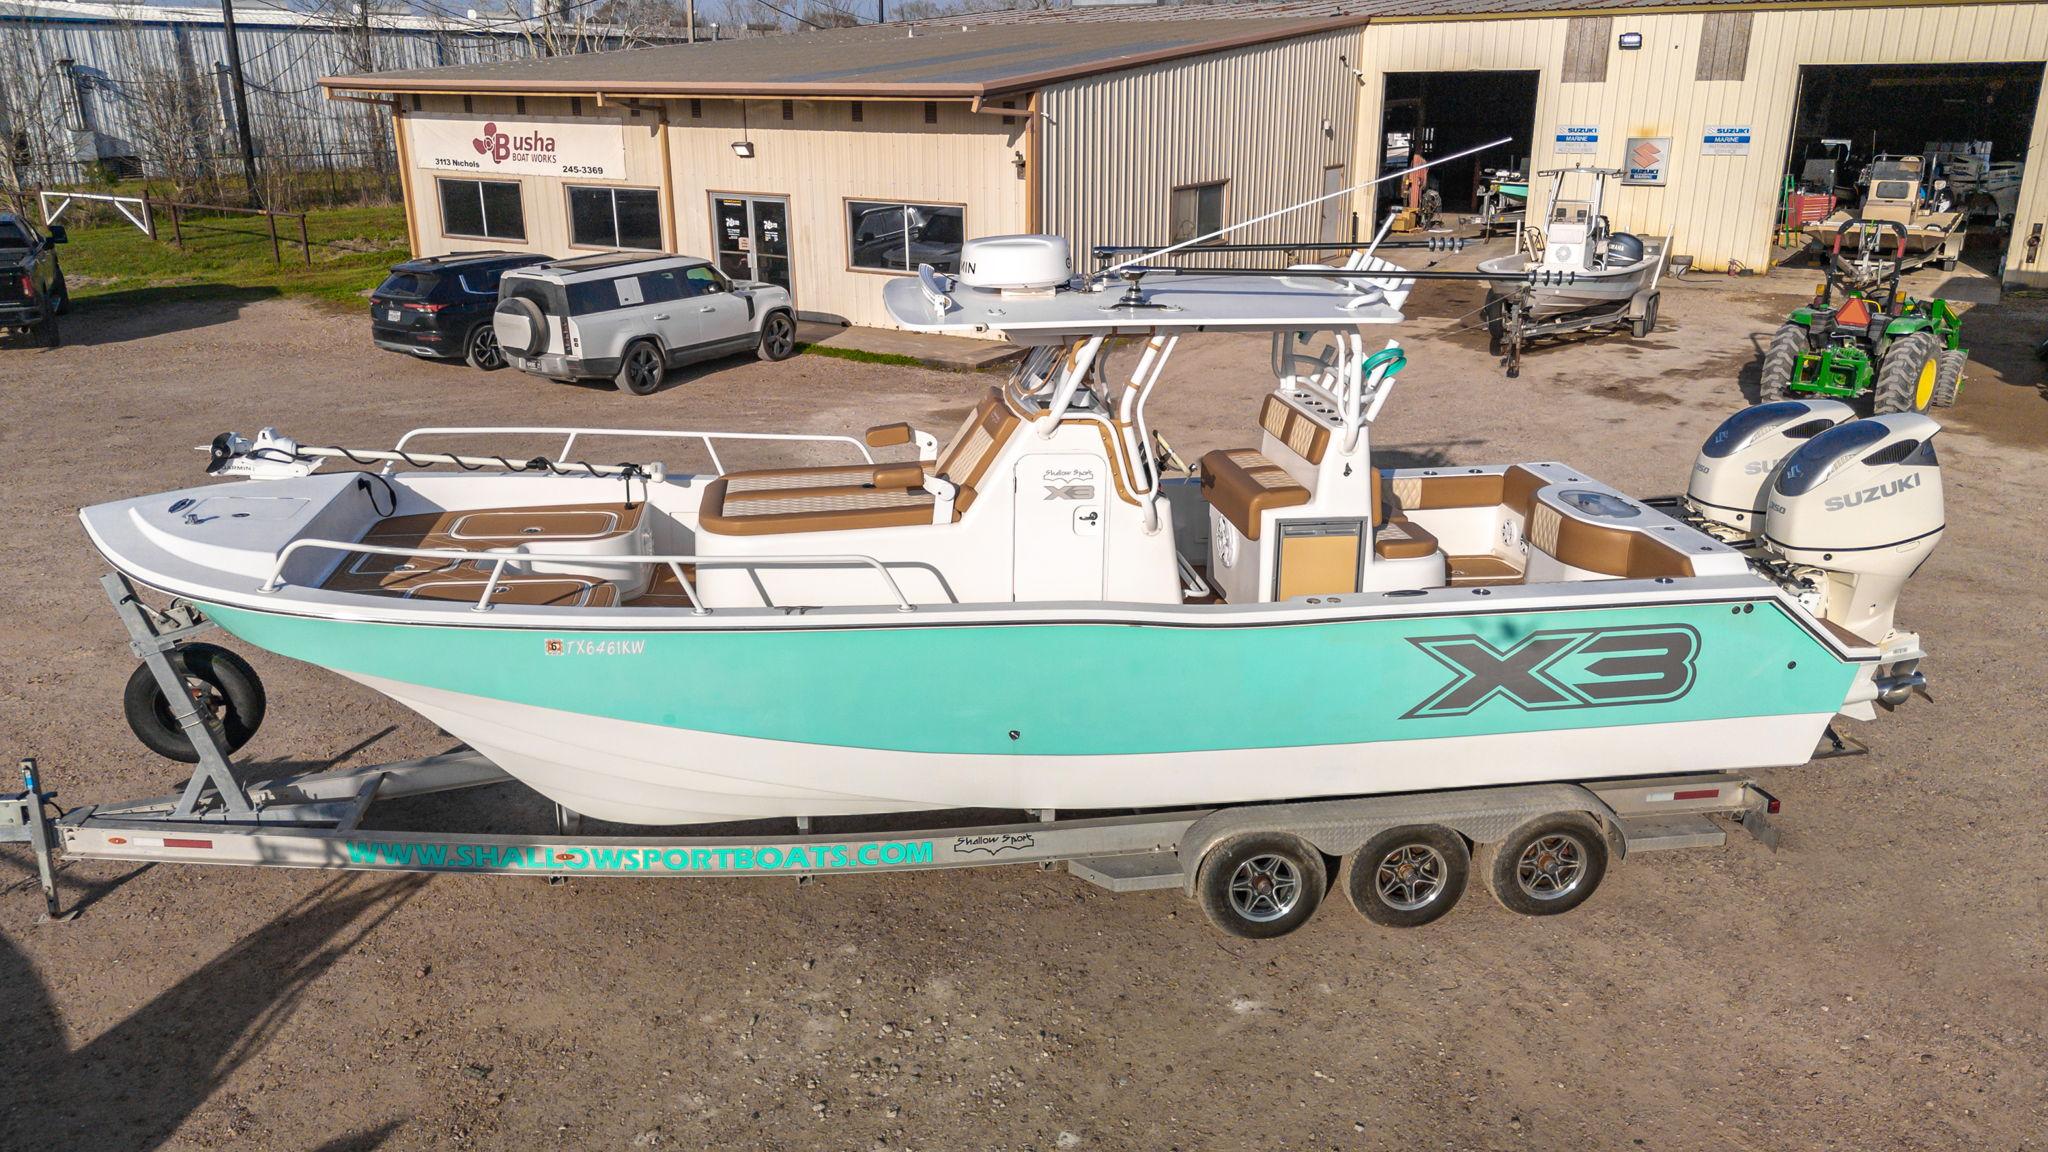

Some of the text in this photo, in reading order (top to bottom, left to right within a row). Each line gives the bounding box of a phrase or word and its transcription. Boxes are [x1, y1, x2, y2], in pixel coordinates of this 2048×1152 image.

[495, 130, 556, 161] Busha
[435, 158, 480, 168] 3113 Nichols
[512, 152, 557, 164] BOAT WORKS
[562, 165, 604, 175] 245-3369
[1043, 485, 1095, 500] X3
[1824, 472, 1921, 512] SUZUKI
[566, 640, 646, 655] TX6461KW
[1397, 623, 1703, 720] X3
[957, 832, 1032, 846] Shallow Sport
[346, 839, 934, 872] WWW.SHALLOWSPORTBOATS.COM
